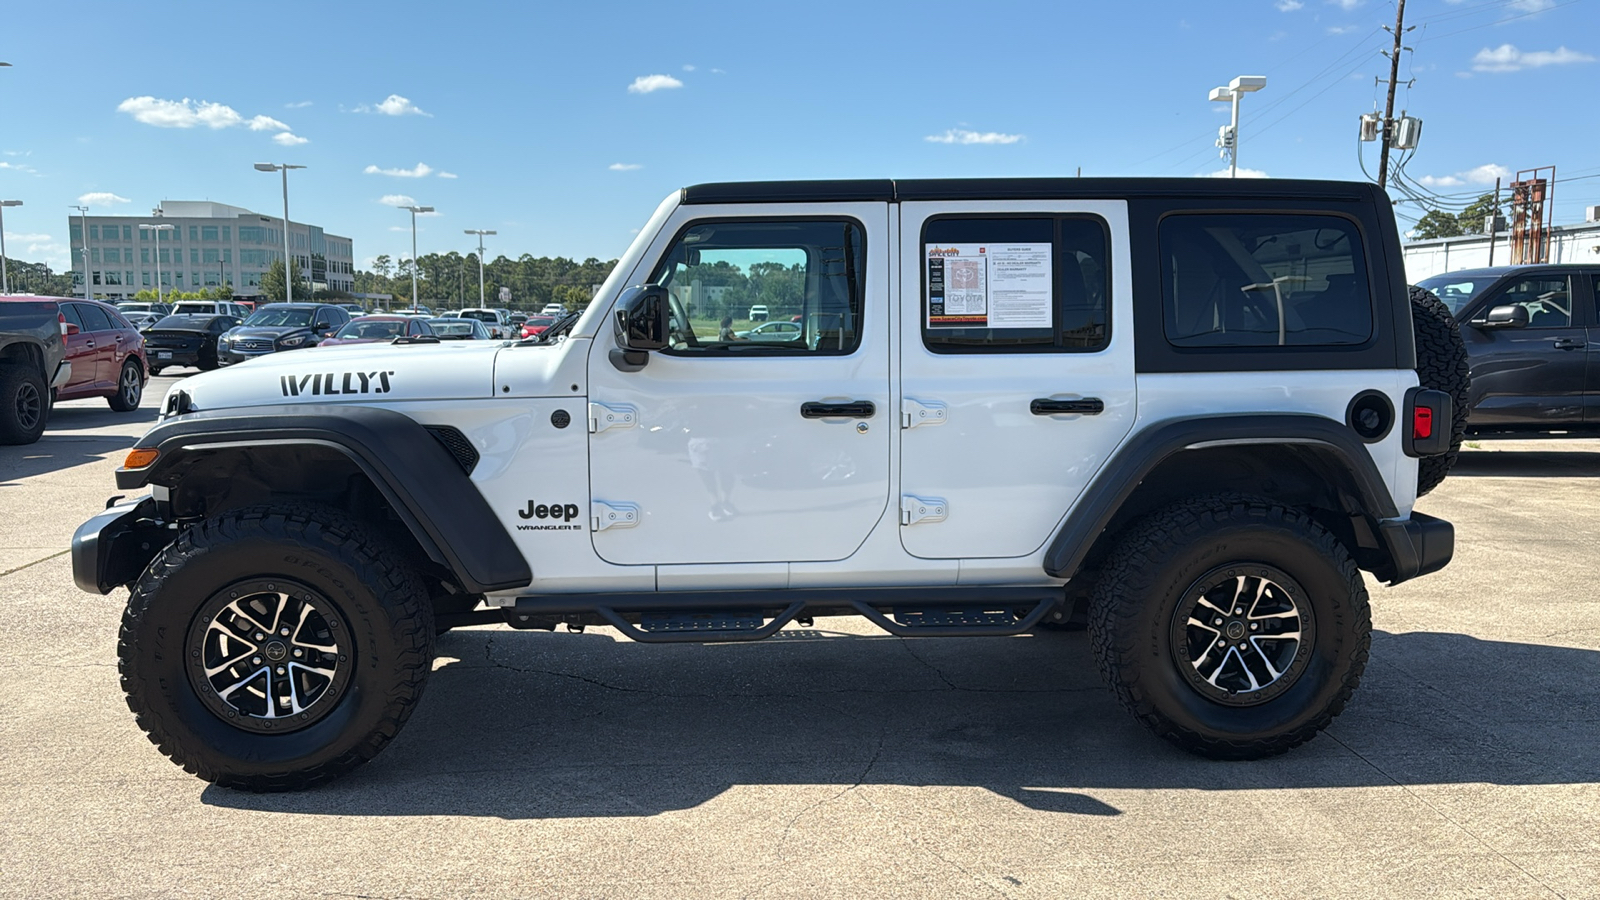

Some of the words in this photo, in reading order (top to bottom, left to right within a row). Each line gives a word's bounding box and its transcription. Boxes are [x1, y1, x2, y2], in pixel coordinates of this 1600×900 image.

[947, 294, 983, 302] TOYOTA
[280, 370, 394, 396] WILLYS
[518, 500, 579, 522] Jeep
